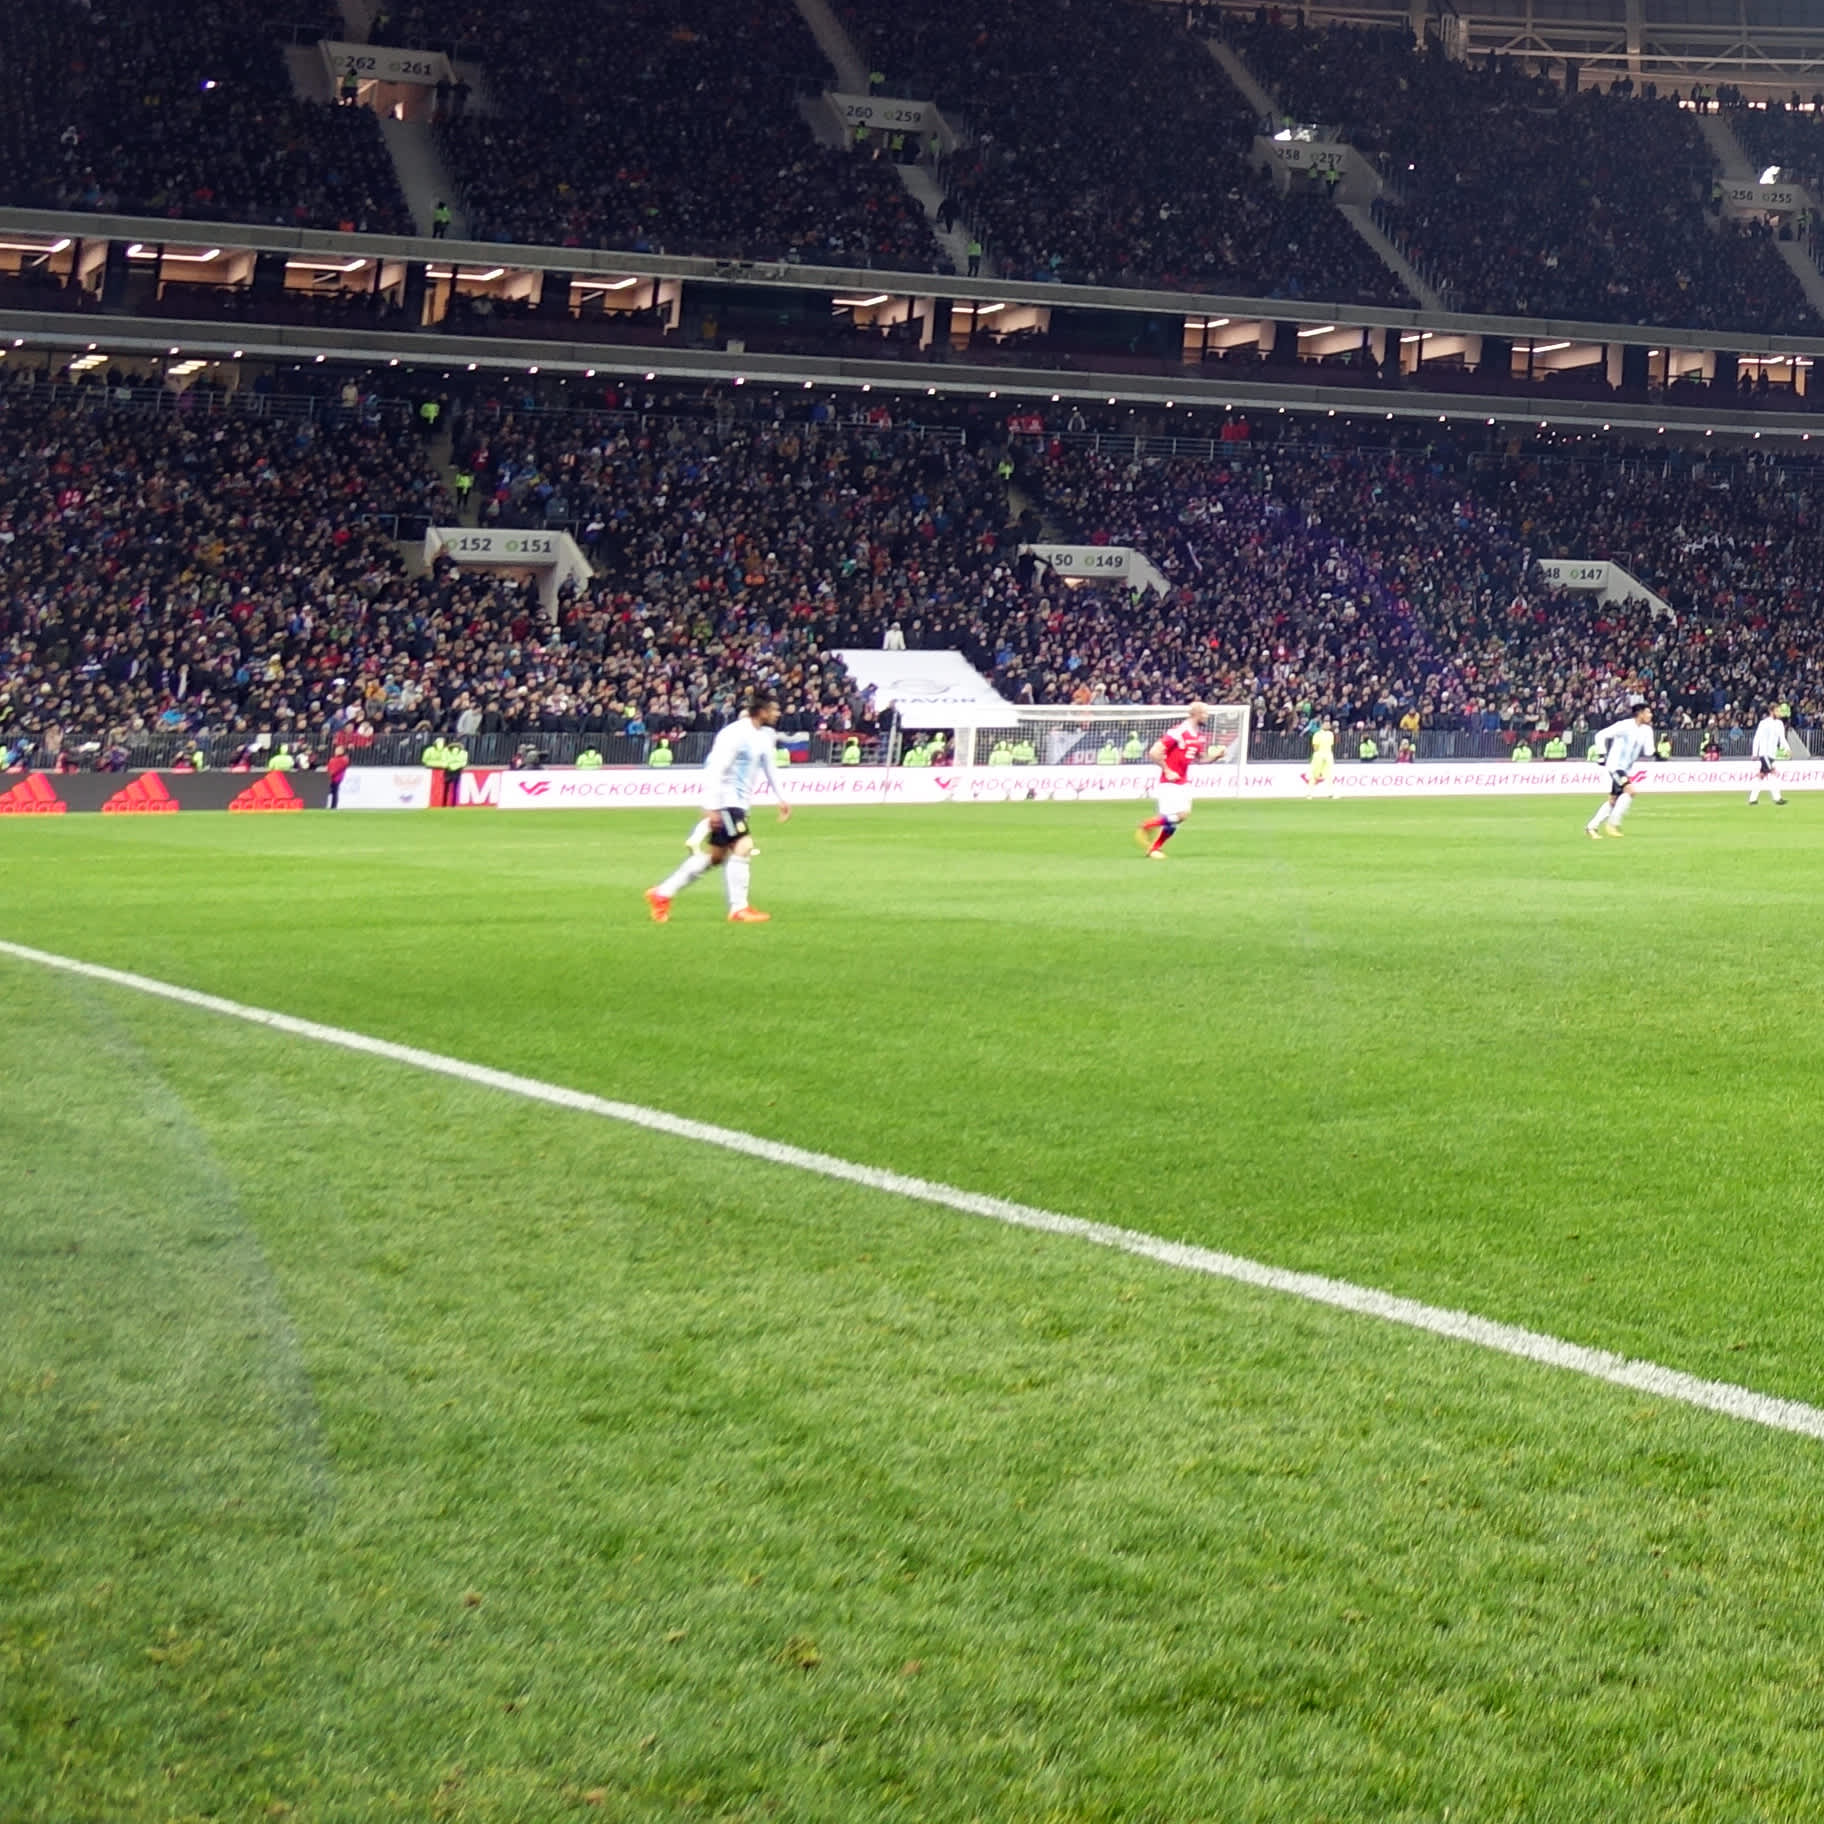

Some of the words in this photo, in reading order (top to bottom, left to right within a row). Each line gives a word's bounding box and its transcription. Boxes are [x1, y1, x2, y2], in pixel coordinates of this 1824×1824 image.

[345, 56, 377, 70] 262
[400, 62, 432, 76] 261
[847, 105, 873, 119] 260
[895, 109, 921, 123] 259
[1277, 148, 1300, 161] 258
[1319, 152, 1342, 165] 257
[1770, 192, 1792, 204] 255
[460, 538, 492, 552] 152
[520, 539, 552, 554] 151
[1096, 555, 1123, 568] 149
[1580, 569, 1603, 581] 147
[851, 778, 904, 793] БАНК
[1105, 773, 1222, 793] КРЕДНЫЙ
[1332, 770, 1452, 787] МОСКОВСКИЙ
[1454, 770, 1556, 787] КРЕДИТНЫЙ
[1559, 772, 1601, 785] БАНК
[101, 799, 179, 815] adidas
[228, 797, 304, 813] adidas
